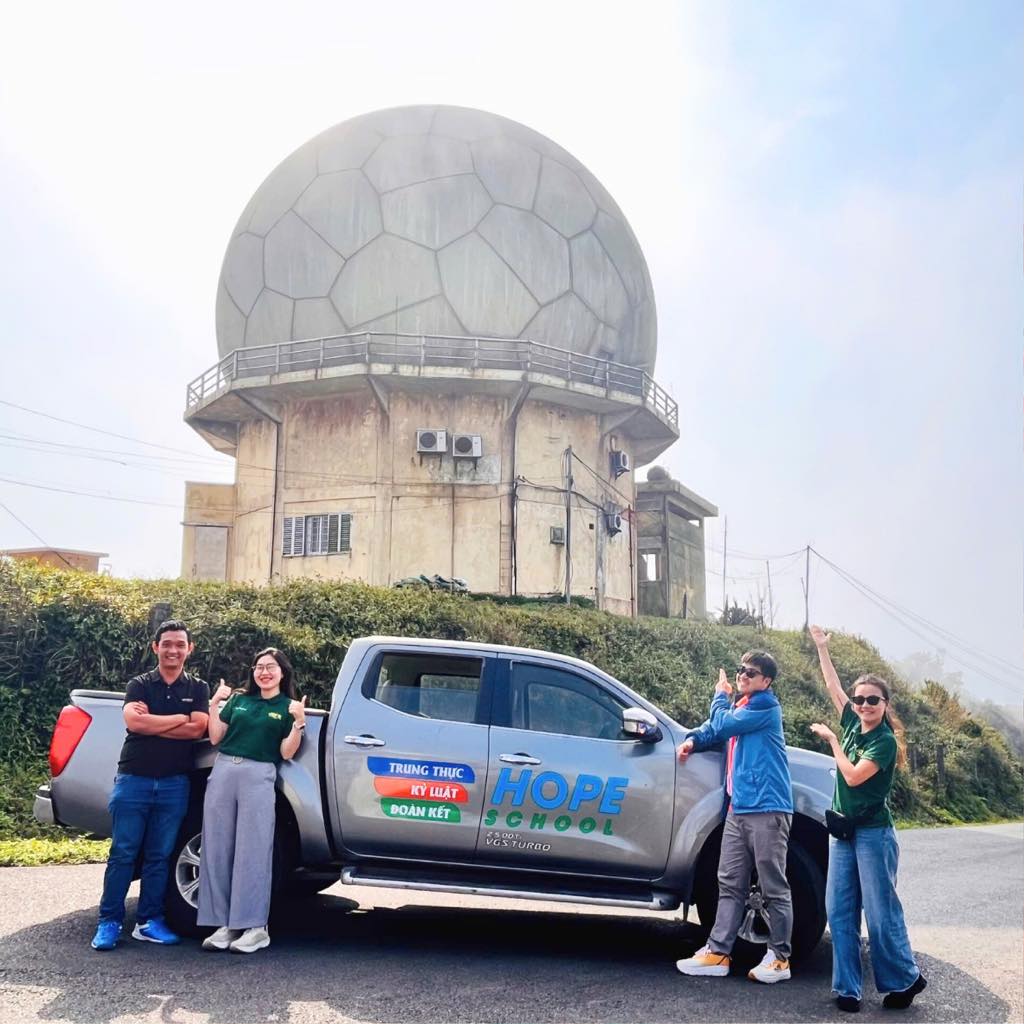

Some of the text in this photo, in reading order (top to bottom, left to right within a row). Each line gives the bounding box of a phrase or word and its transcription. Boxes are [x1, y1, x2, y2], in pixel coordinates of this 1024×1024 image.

[389, 762, 464, 779] TRUNG THỰC
[410, 783, 458, 800] KỶ LUẬT
[490, 766, 629, 815] HOPE
[390, 804, 451, 819] ĐOÀN KẾT
[485, 809, 614, 836] SCHOOL
[511, 840, 551, 852] TURBO
